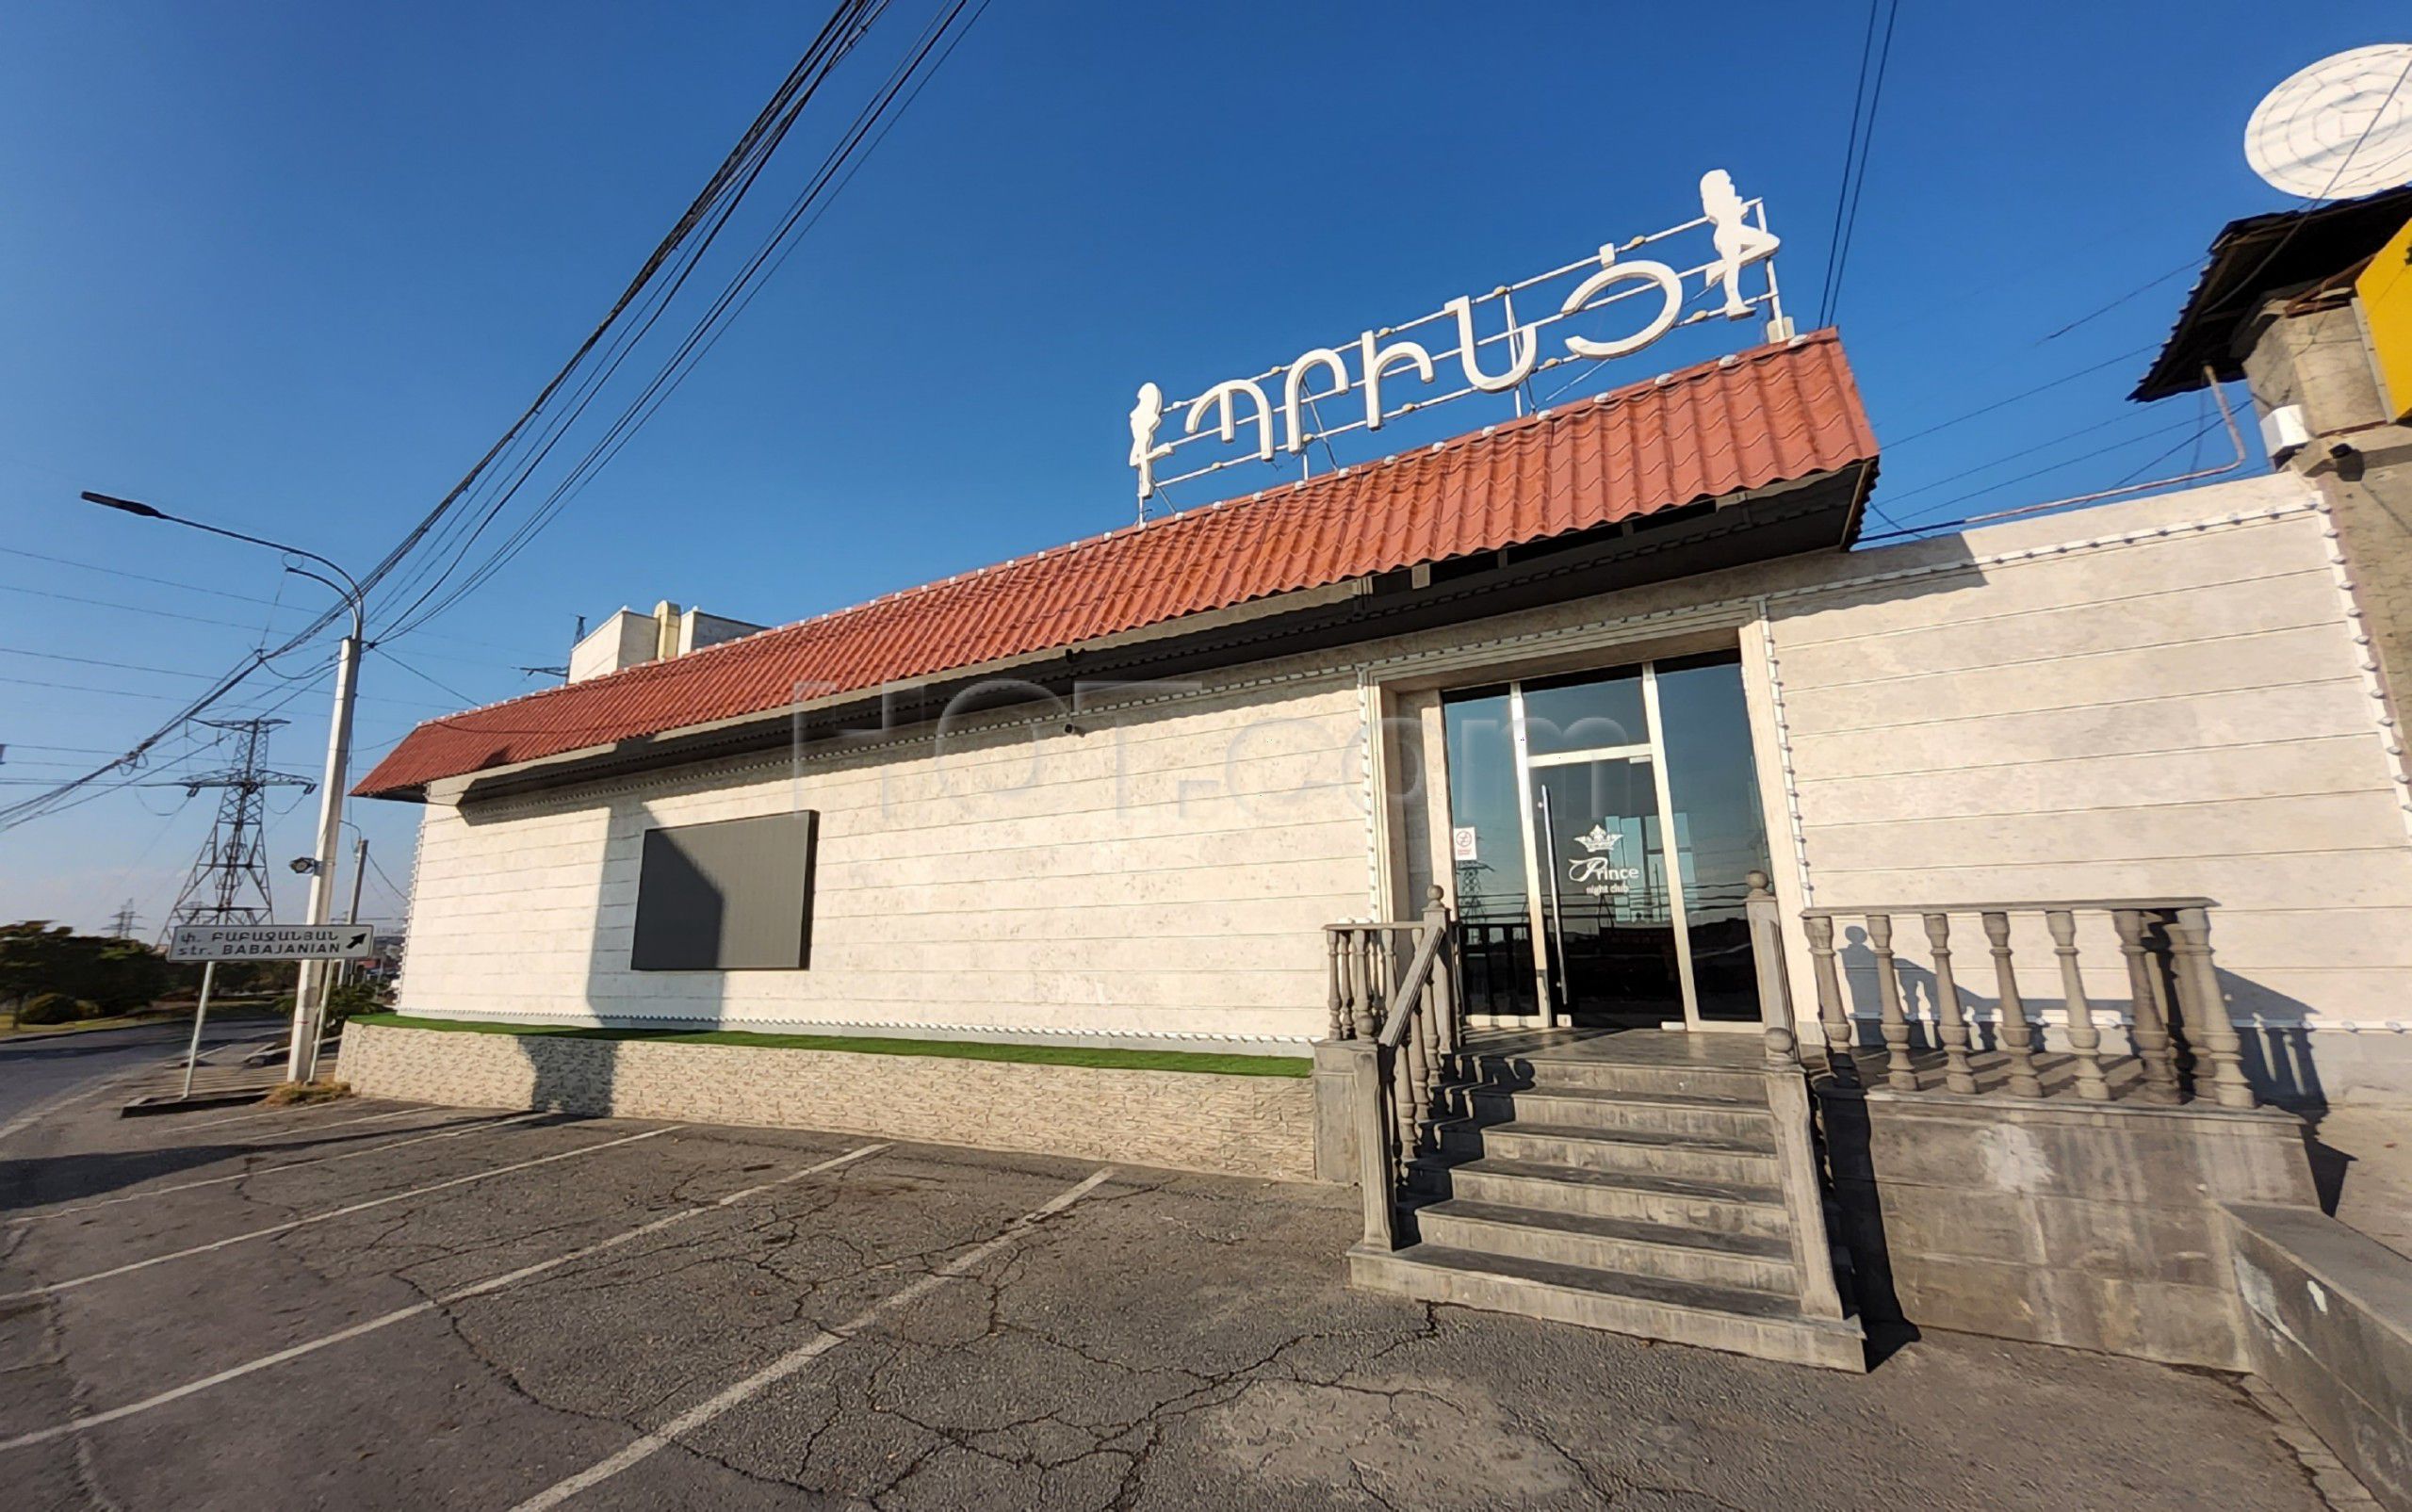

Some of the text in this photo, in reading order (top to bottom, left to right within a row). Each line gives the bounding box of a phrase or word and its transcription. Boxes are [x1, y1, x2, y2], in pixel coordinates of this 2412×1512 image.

[1569, 857, 1638, 882] Prince
[1587, 882, 1629, 896] night club
[177, 944, 340, 955] str. BABAJANIAN
